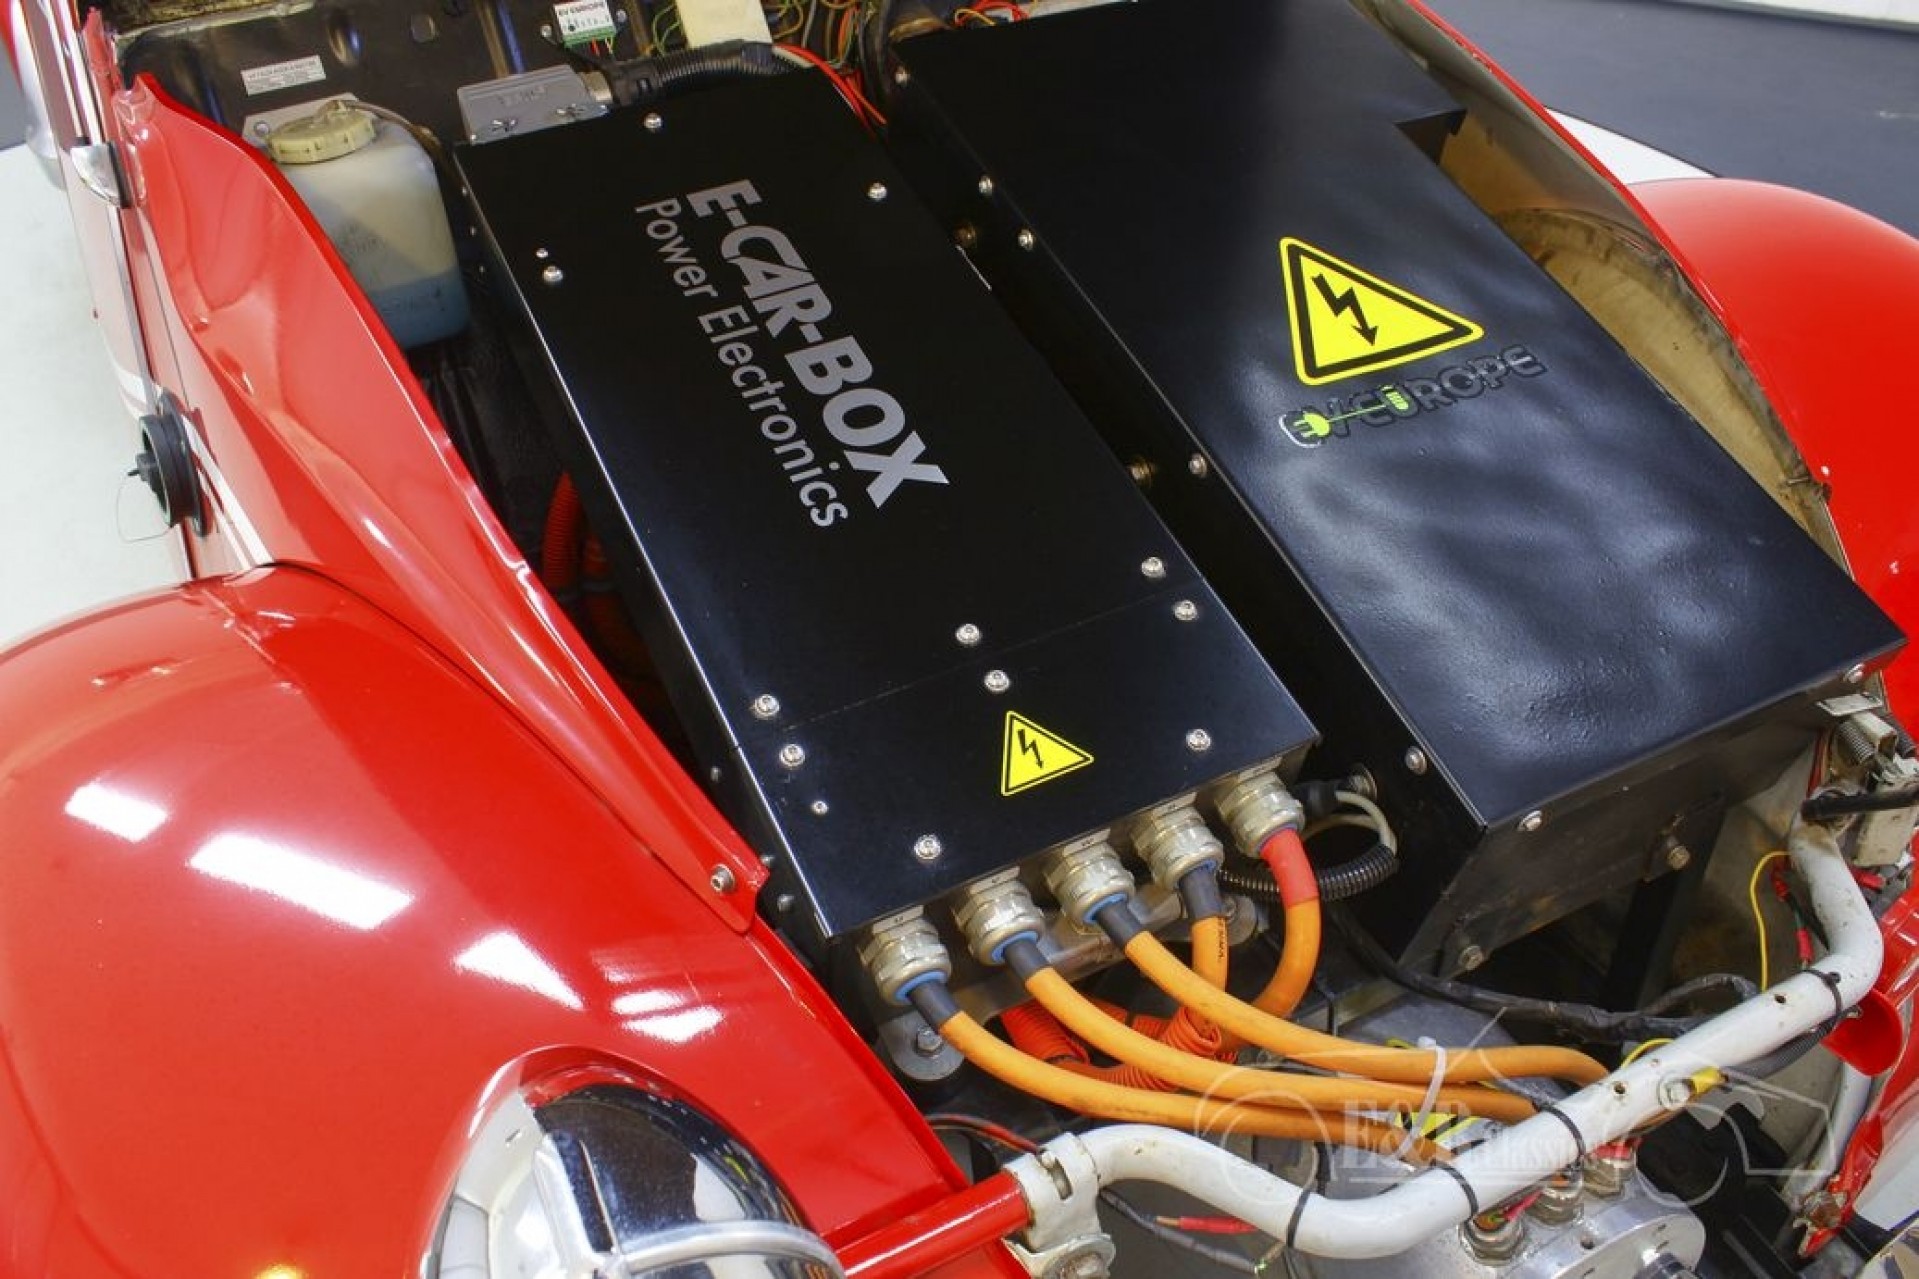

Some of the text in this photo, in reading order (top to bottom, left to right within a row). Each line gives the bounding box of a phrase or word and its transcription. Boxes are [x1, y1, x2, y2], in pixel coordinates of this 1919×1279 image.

[636, 197, 848, 527] Power Electronics
[687, 179, 949, 508] E-CAR-BOX
